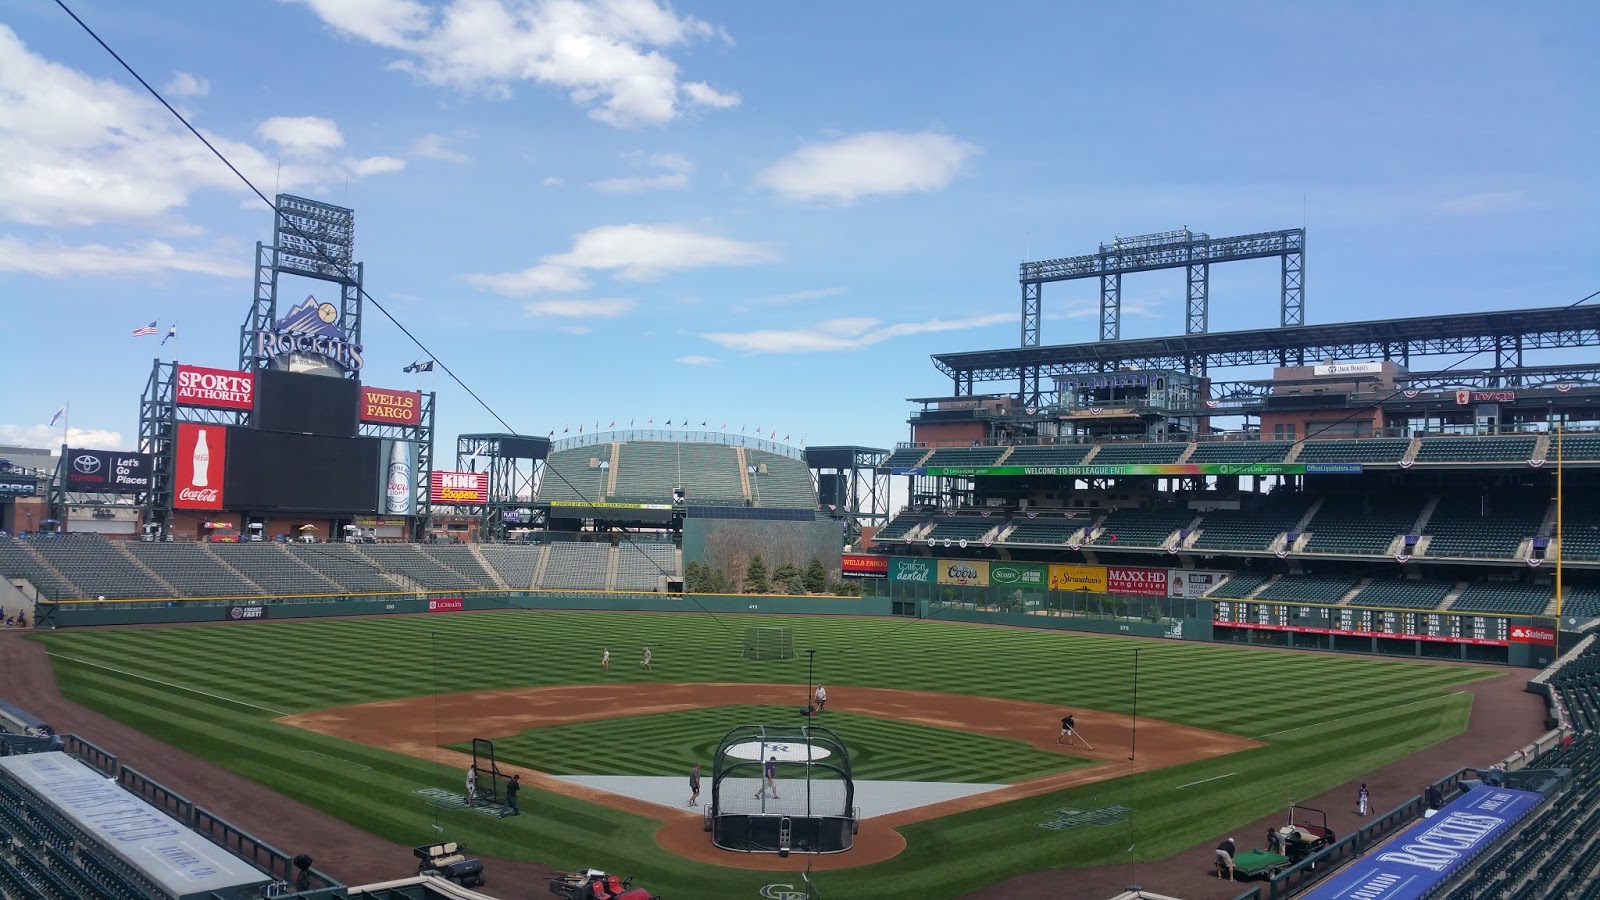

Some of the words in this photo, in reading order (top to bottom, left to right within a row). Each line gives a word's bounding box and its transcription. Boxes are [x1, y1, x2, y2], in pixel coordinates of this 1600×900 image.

[178, 372, 252, 394] SPORTS
[366, 392, 413, 408] WELLS
[1473, 391, 1514, 401] TAVERN
[366, 404, 413, 420] FARGO
[116, 458, 139, 467] Let's
[116, 466, 130, 475] Go
[70, 474, 104, 482] TOYOTA
[116, 475, 148, 485] Places
[441, 474, 478, 488] KING
[387, 480, 409, 491] Coors
[440, 487, 478, 502] Soopers
[898, 560, 926, 570] Comfort
[896, 568, 927, 582] dental
[948, 565, 978, 579] Coors
[1060, 572, 1102, 584] Stranahan's
[1109, 570, 1145, 582] MAXX
[1109, 580, 1165, 589] sunglasses
[1524, 629, 1554, 640] StateFarm
[1376, 811, 1506, 872] ROCKIES
[1350, 872, 1402, 900] COLORADO
